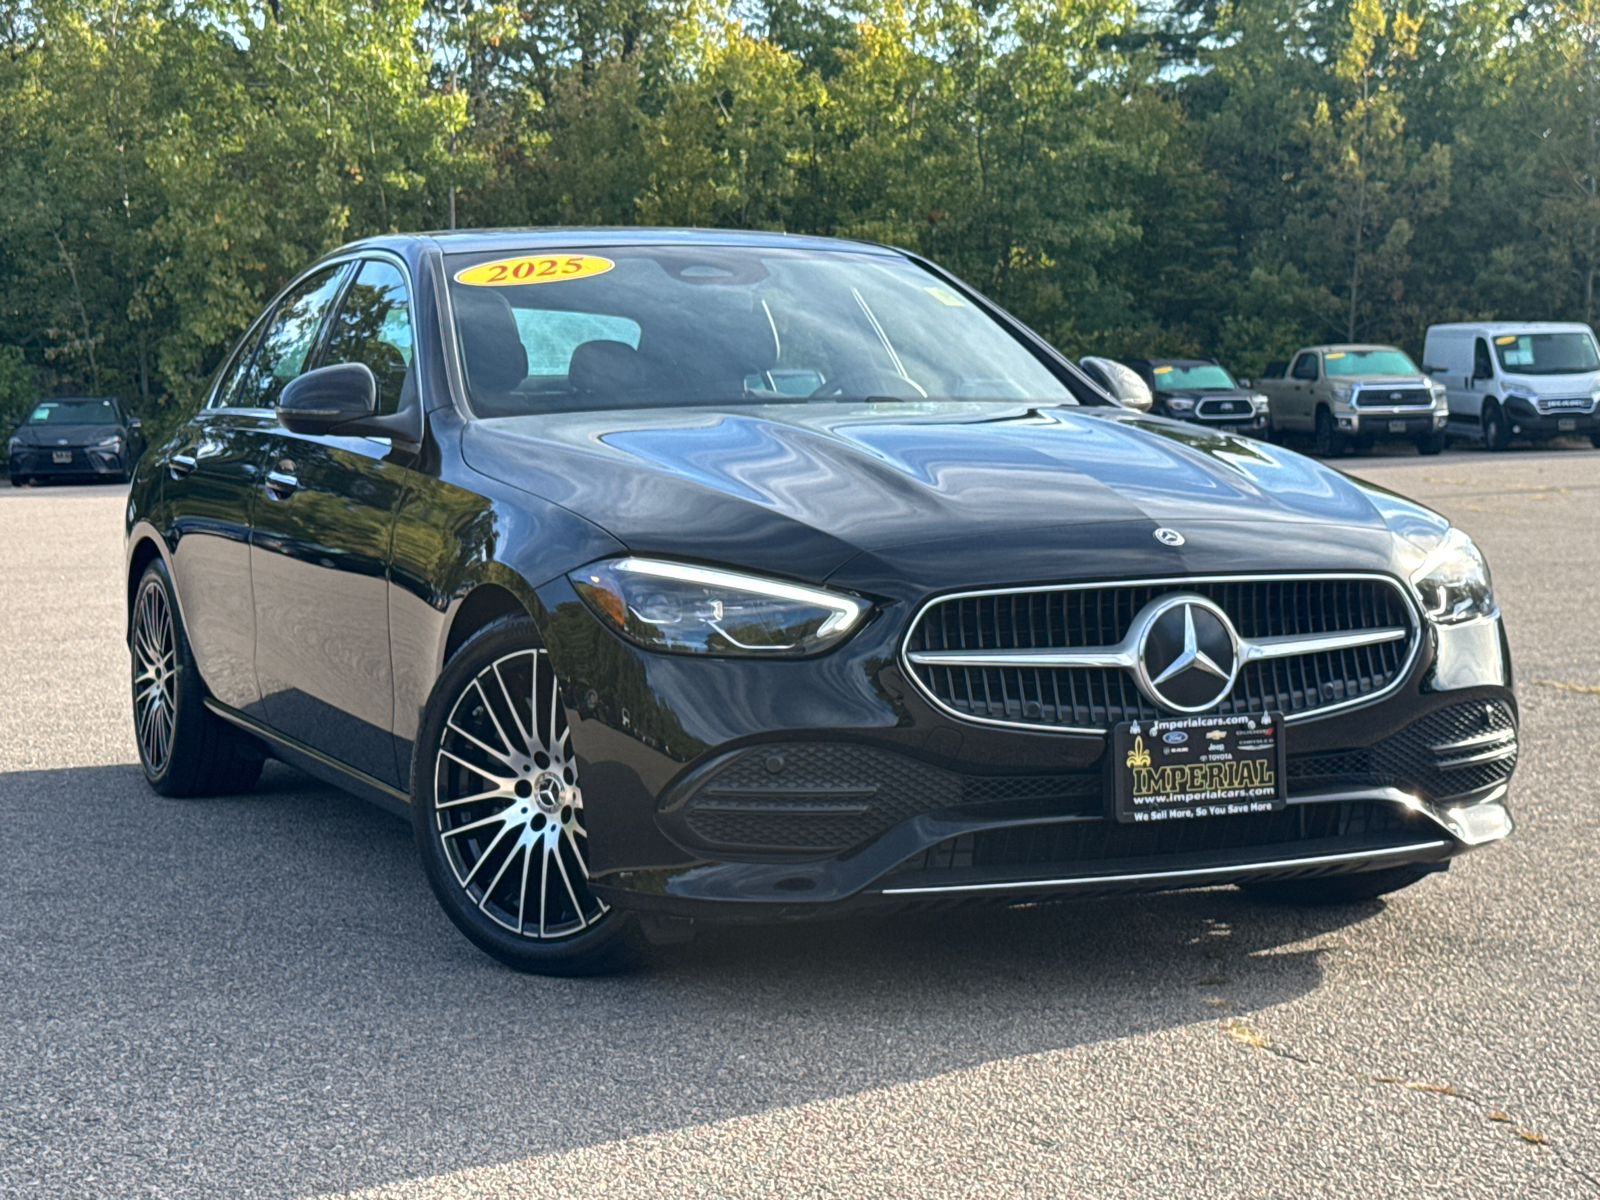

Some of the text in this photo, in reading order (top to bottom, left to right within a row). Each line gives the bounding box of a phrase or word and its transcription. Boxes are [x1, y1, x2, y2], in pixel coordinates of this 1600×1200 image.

[486, 257, 584, 283] 2025
[1208, 742, 1225, 752] Jeep
[1208, 753, 1233, 762] TOYOTA
[1133, 759, 1275, 796] IMPERIAL
[1133, 787, 1275, 805] www.imperialcars.com
[1134, 802, 1272, 822] We Sell More, So You Save More
